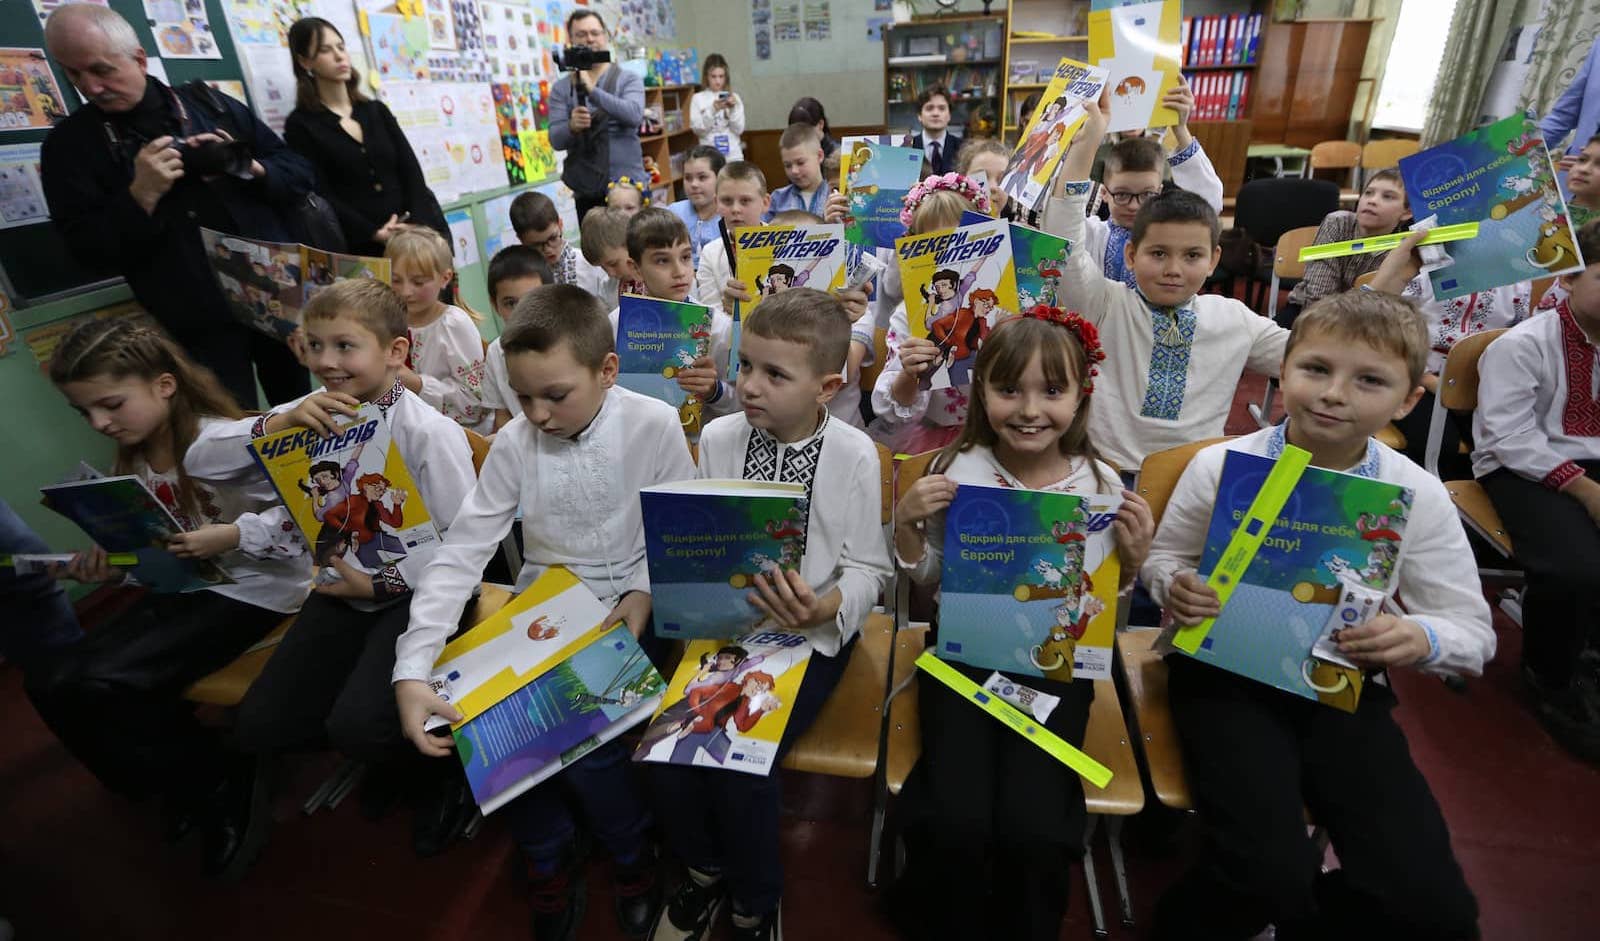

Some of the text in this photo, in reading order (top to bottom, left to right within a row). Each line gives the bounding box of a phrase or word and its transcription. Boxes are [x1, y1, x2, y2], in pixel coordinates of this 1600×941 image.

[1422, 176, 1465, 198] Відкрий
[1465, 166, 1487, 181] для
[1427, 182, 1480, 211] Європу!
[738, 230, 807, 250] ЧЕКЕРИ
[771, 238, 840, 259] ЧИТЕРІВ
[900, 231, 969, 260] ЧЕКЕРИ
[934, 234, 1005, 265] ЧИТЕРІВ
[261, 424, 322, 459] ЧЕКЕ
[959, 532, 1054, 545] Відкрий для себе
[1291, 520, 1319, 533] для
[1321, 526, 1356, 538] себе
[960, 548, 1015, 564] Європу!
